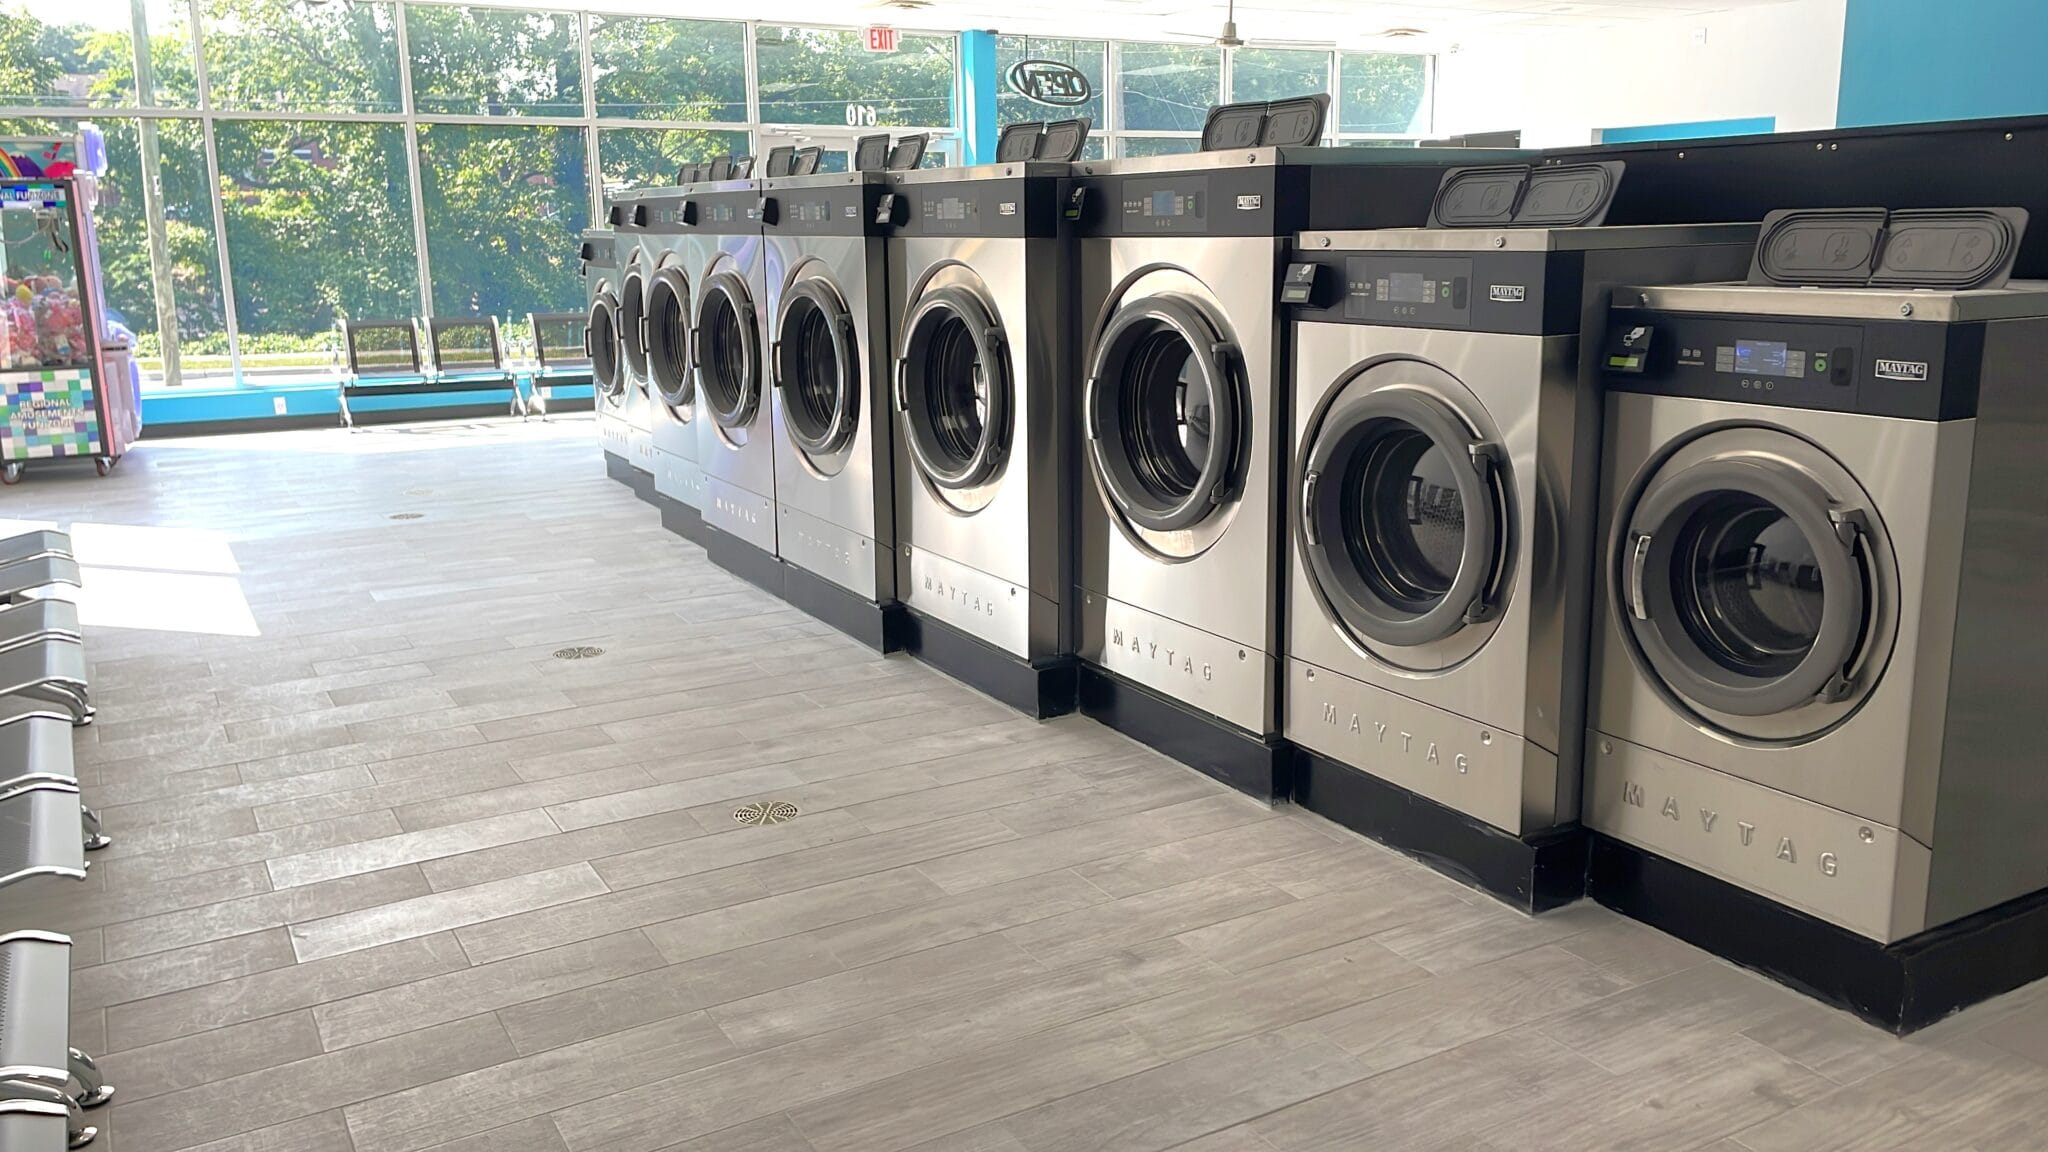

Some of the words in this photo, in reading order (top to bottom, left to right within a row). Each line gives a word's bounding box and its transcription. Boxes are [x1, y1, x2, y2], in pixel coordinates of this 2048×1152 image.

[870, 29, 893, 50] EXIT
[1879, 362, 1924, 374] MAYTAG
[20, 399, 72, 409] REGIONAL
[22, 420, 46, 430] FUN
[924, 574, 994, 617] MAYTAG
[1113, 628, 1212, 682] MAYTAG
[1323, 702, 1468, 775] MAYTAG
[1623, 781, 1838, 878] MAYTAG
